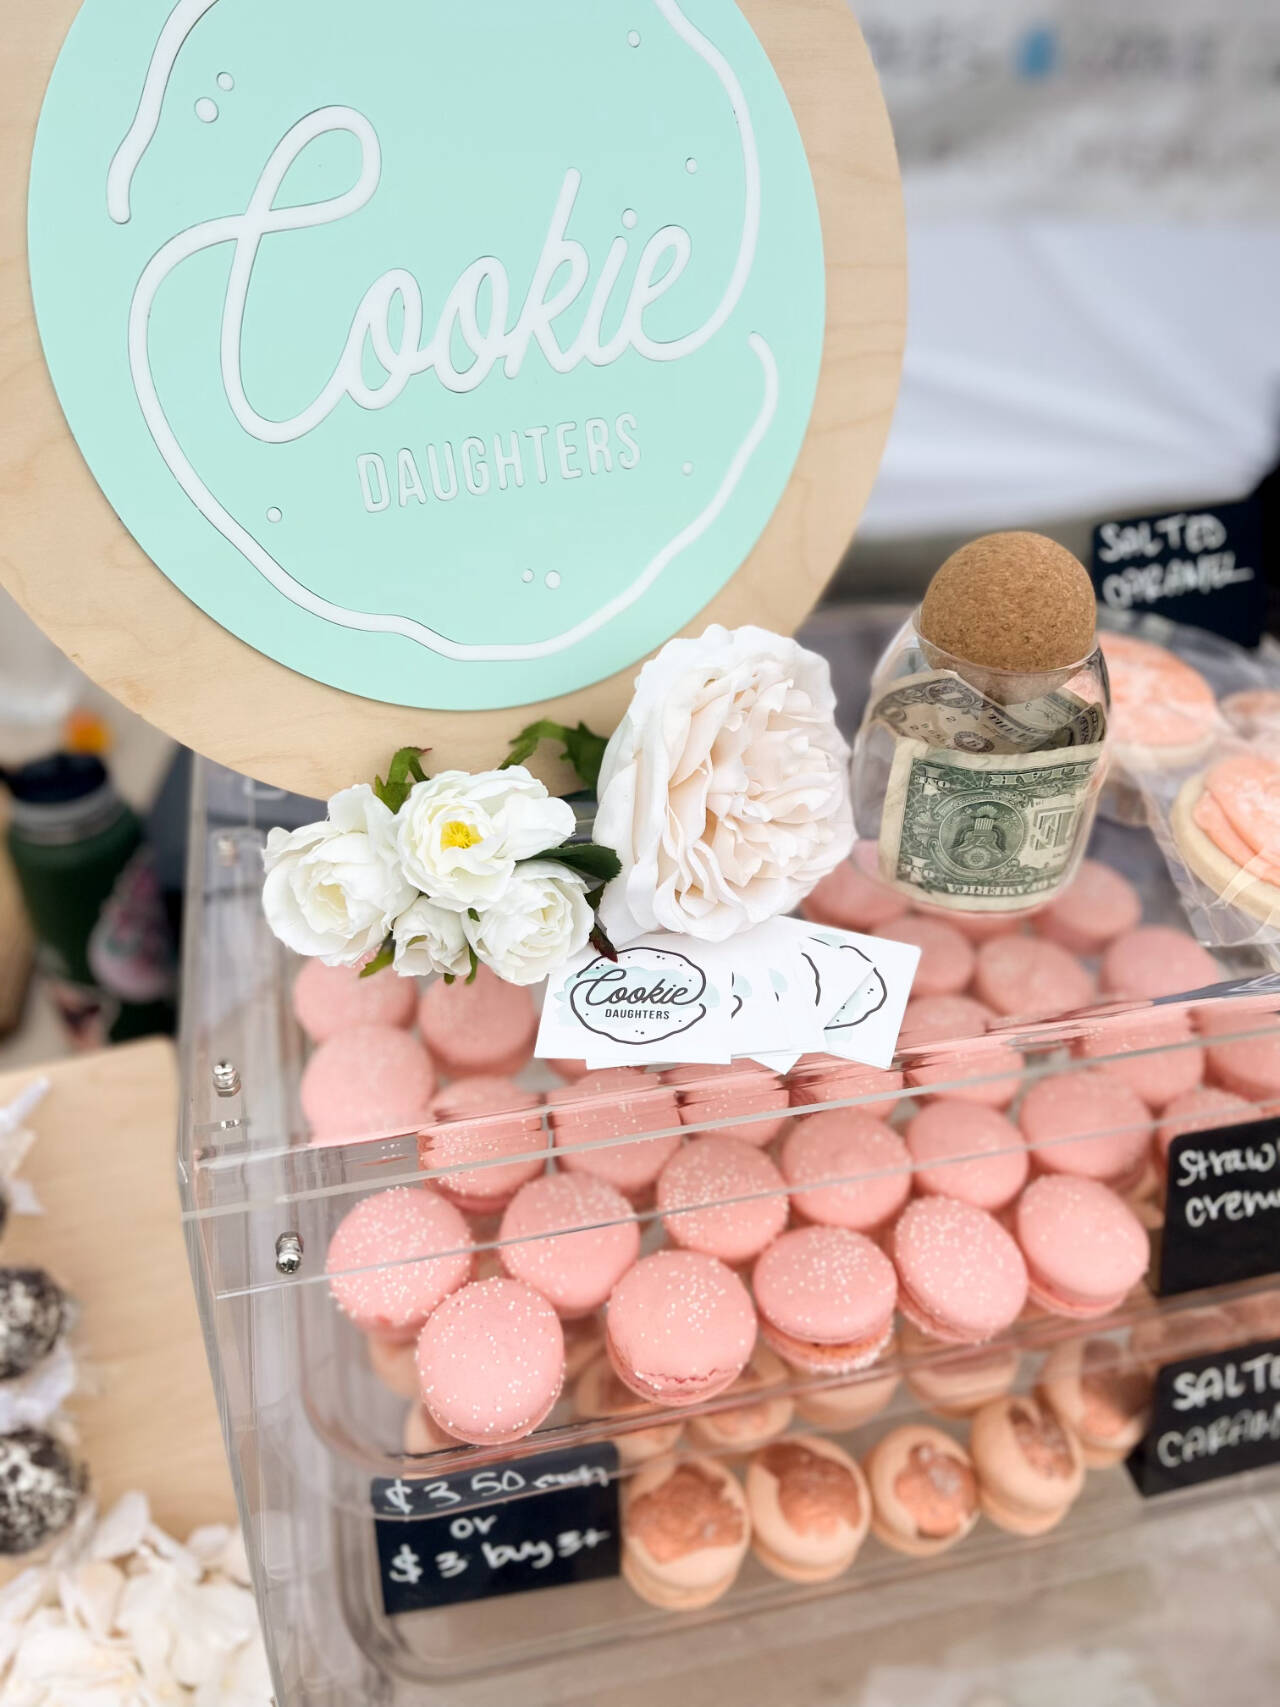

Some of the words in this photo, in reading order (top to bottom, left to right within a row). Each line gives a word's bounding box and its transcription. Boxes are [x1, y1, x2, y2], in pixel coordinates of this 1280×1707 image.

[218, 104, 693, 443] Cookie
[356, 412, 641, 513] DAUGHTERS
[585, 968, 688, 1006] Cookie
[604, 1008, 670, 1020] DAUGHTERS
[450, 1514, 497, 1539] or
[481, 1541, 554, 1569] buy
